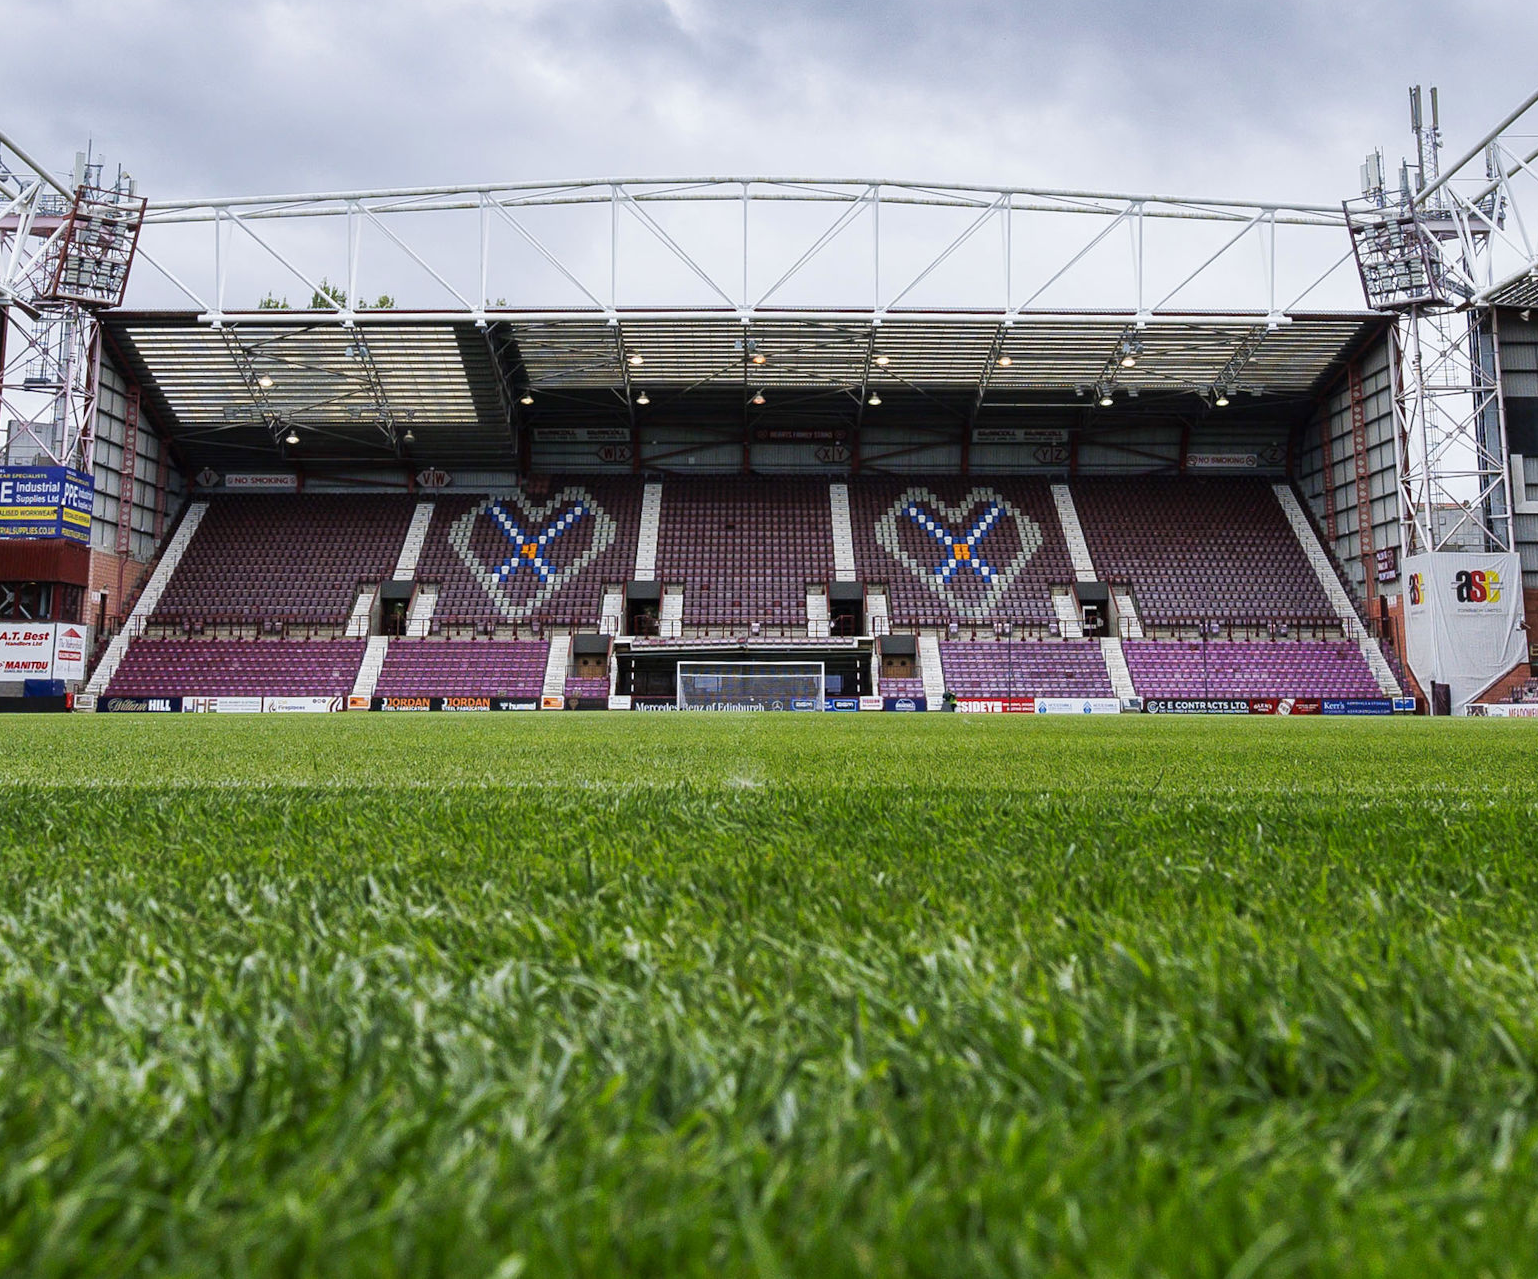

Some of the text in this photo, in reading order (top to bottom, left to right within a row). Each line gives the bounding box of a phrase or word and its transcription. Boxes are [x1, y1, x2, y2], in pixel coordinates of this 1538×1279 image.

[604, 448, 625, 459] W X
[823, 449, 843, 459] X Y
[1042, 449, 1062, 460] Y Z
[204, 472, 211, 484] V
[234, 476, 289, 485] NO SMOKING
[423, 475, 444, 485] V W
[16, 482, 60, 493] Industrial
[16, 494, 59, 504] Supplies Ltd
[63, 483, 78, 507] PPE
[0, 632, 50, 640] A.T. Best
[5, 661, 48, 670] MANITOU
[108, 698, 171, 712] William HILL
[184, 699, 218, 713] JHE
[509, 702, 536, 710] hummel
[706, 702, 716, 711] of
[718, 702, 764, 711] Edinburgh
[962, 702, 994, 712] SIDEY
